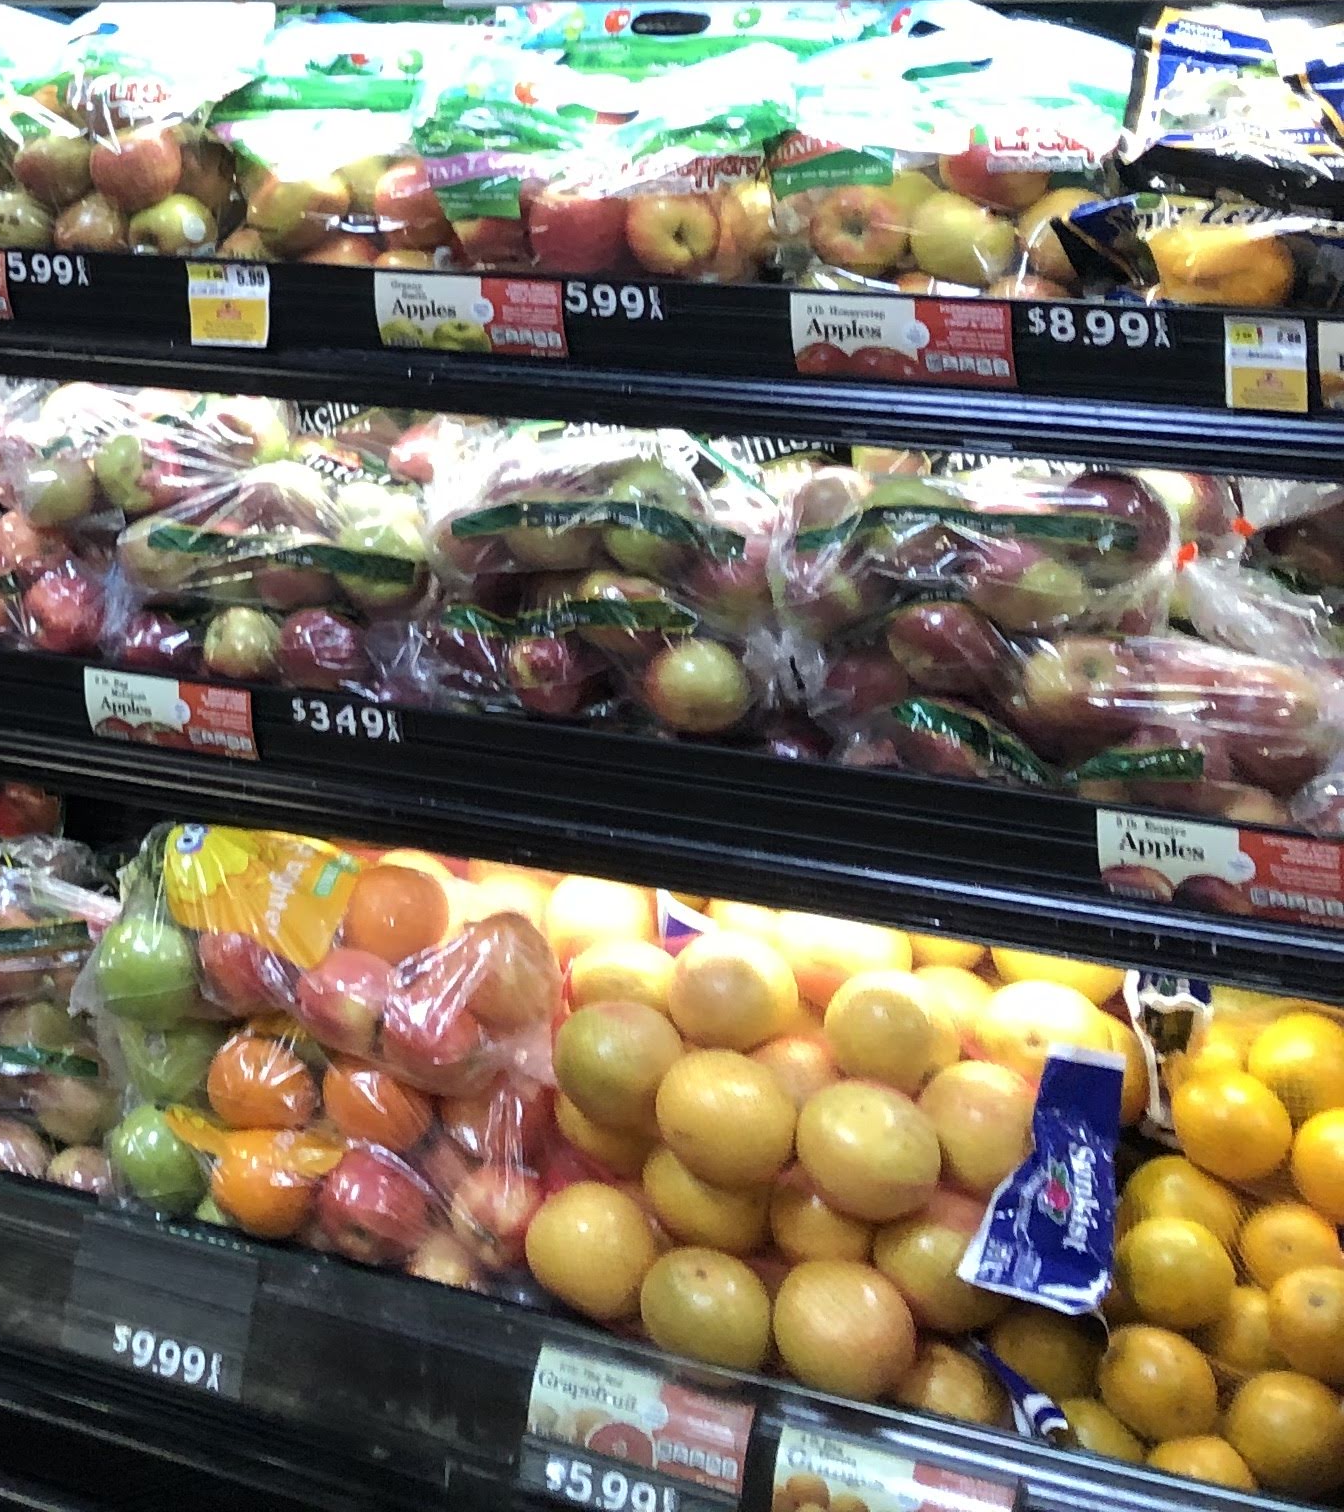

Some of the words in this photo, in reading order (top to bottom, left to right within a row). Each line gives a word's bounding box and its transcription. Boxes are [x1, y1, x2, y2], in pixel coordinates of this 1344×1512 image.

[7, 250, 74, 286] 5.99
[391, 299, 457, 322] Apples
[565, 281, 645, 320] 5.99
[806, 317, 882, 343] Apples
[1027, 305, 1149, 349] $8.99
[100, 695, 153, 718] Apples
[1119, 831, 1206, 862] Apples
[1062, 1140, 1101, 1255] Sunkist
[112, 1322, 206, 1385] $9.99
[537, 1368, 638, 1412] Grapefruit
[545, 1453, 658, 1512] $5.99
